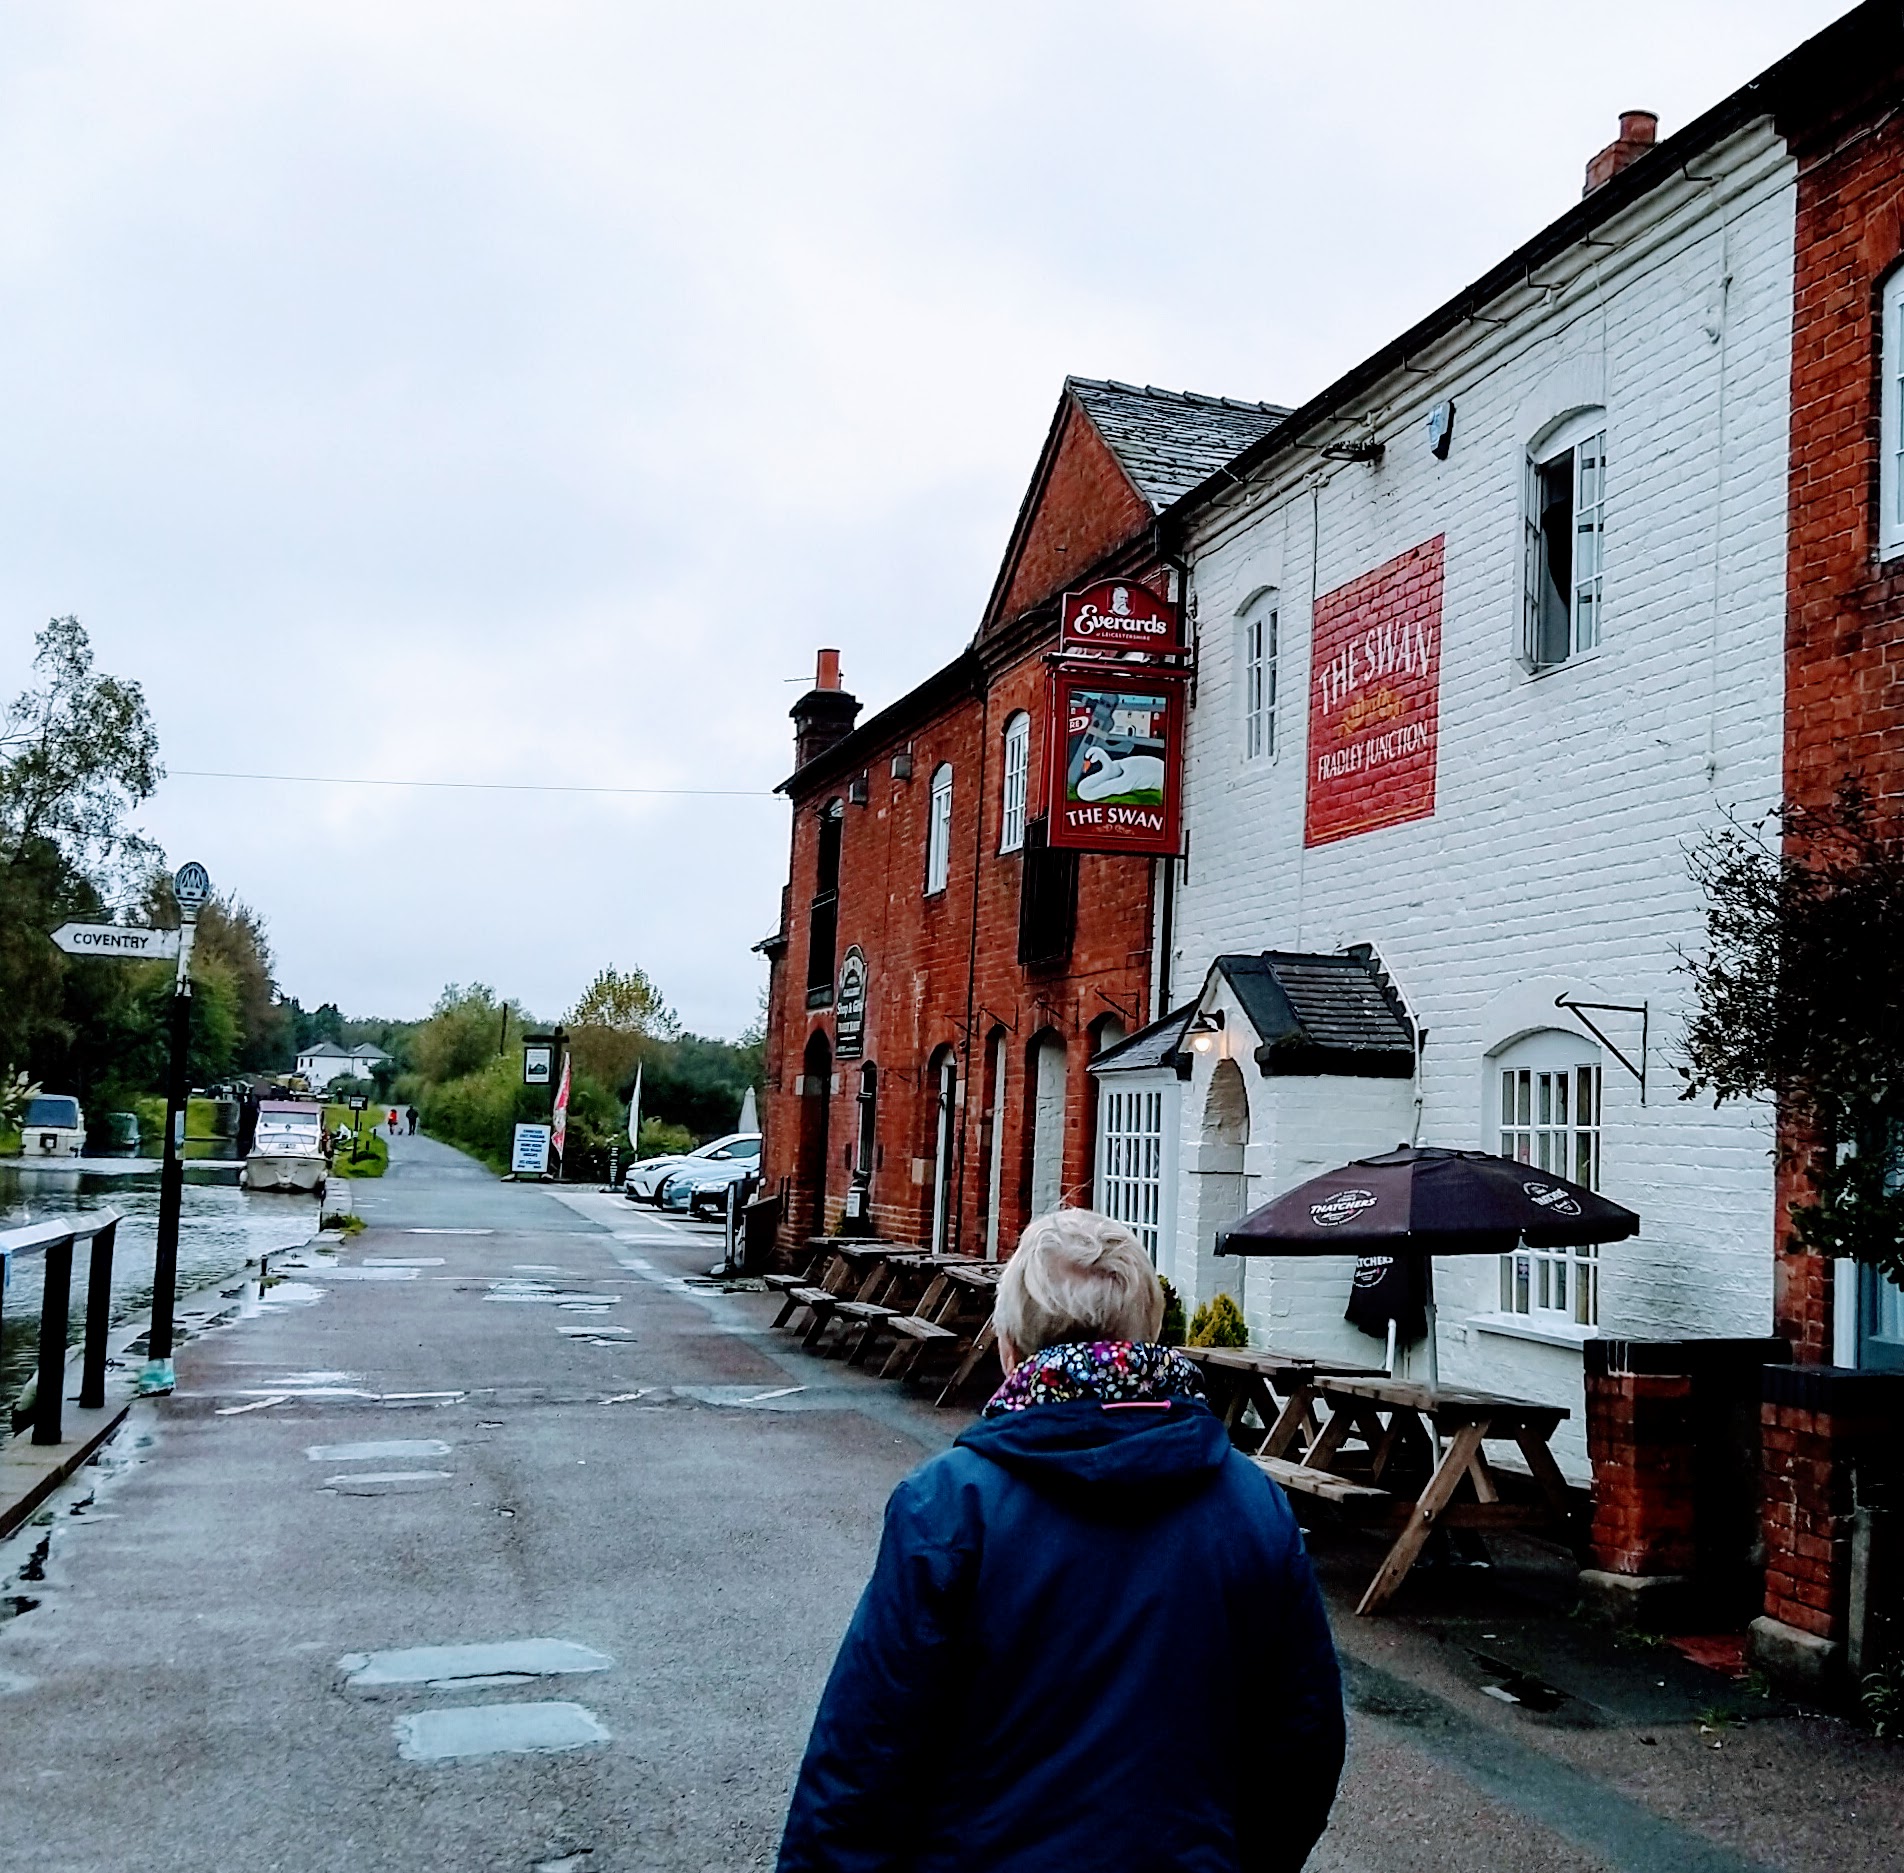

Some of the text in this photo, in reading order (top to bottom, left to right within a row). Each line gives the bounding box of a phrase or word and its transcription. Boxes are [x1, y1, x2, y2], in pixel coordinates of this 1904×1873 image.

[1074, 604, 1167, 635] Everards
[1318, 621, 1434, 716] THE SWAN
[1317, 719, 1428, 782] FRADLEY JUNCTION
[1065, 807, 1164, 831] THE SWAN
[73, 932, 149, 949] COVENTRY
[1310, 1196, 1378, 1215] THATCHERS
